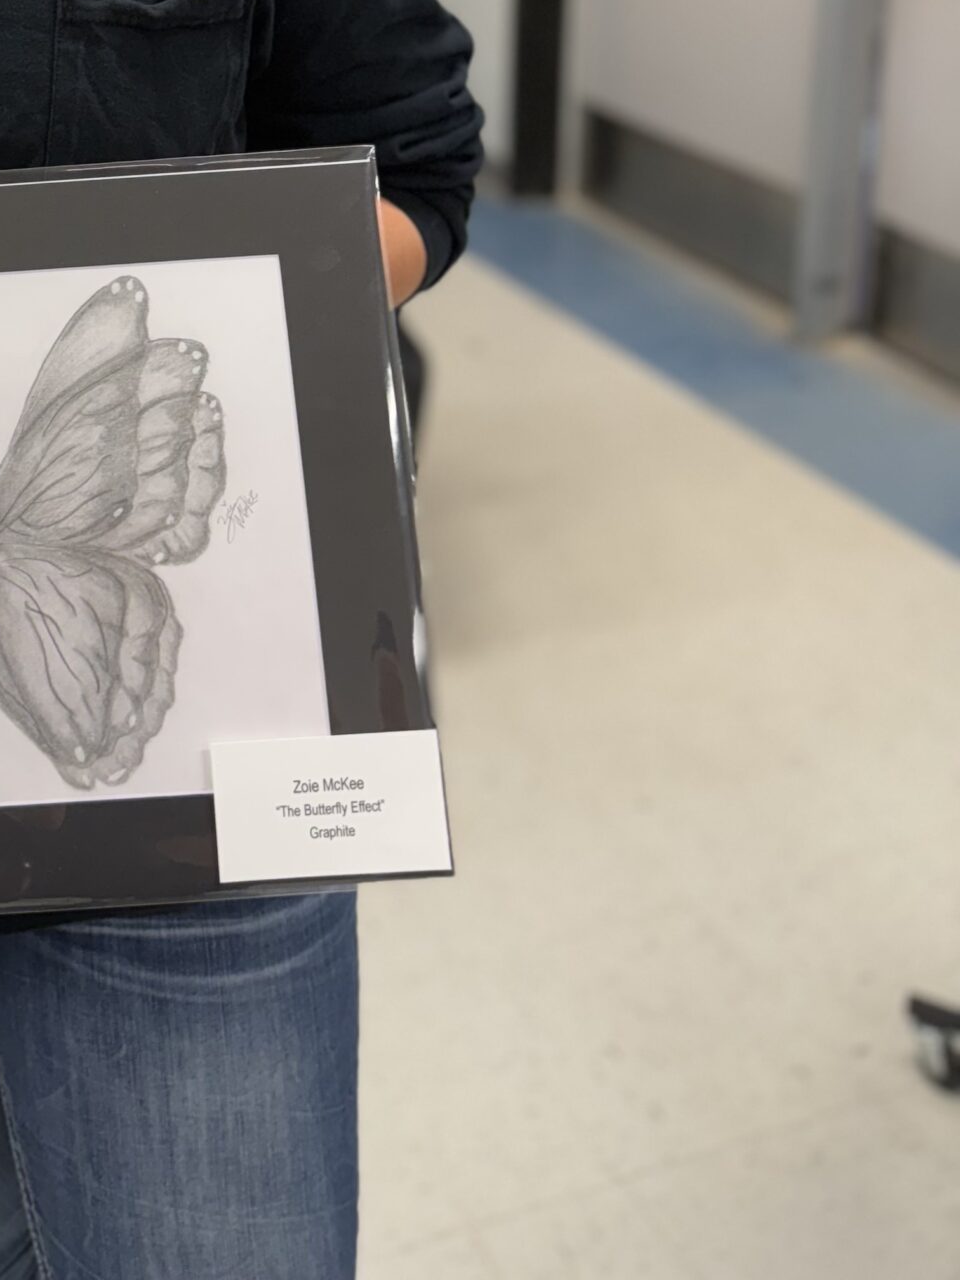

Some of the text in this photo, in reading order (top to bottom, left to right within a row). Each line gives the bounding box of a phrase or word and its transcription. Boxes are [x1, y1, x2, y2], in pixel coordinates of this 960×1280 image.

[293, 777, 364, 793] Zoie McKee
[304, 802, 347, 817] Butterfly
[309, 825, 355, 840] Graphite
